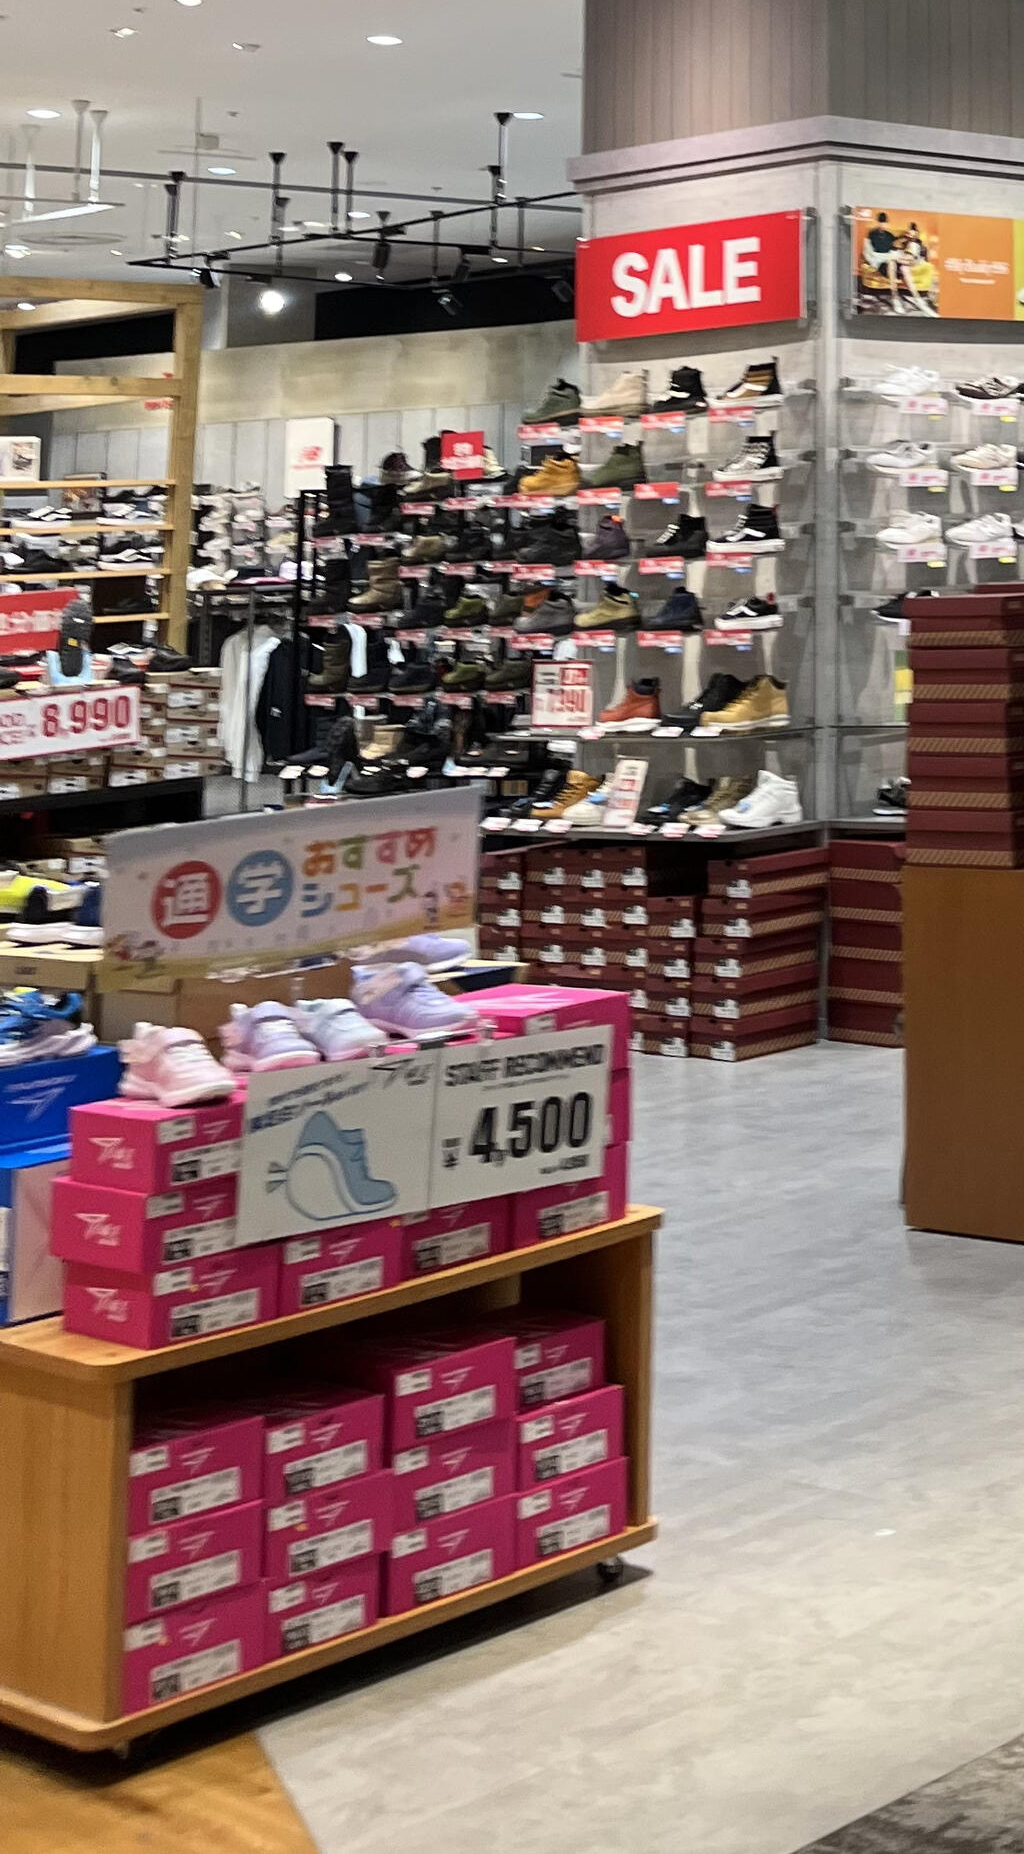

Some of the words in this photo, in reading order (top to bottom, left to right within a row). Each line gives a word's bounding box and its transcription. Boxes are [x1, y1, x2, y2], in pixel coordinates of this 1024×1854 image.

[610, 235, 762, 318] SALE
[302, 827, 439, 878] おすすめ
[301, 863, 421, 918] シューズ
[444, 1060, 501, 1087] STAFF
[504, 1043, 605, 1079] RECOMMEND
[467, 1091, 593, 1168] 4,500
